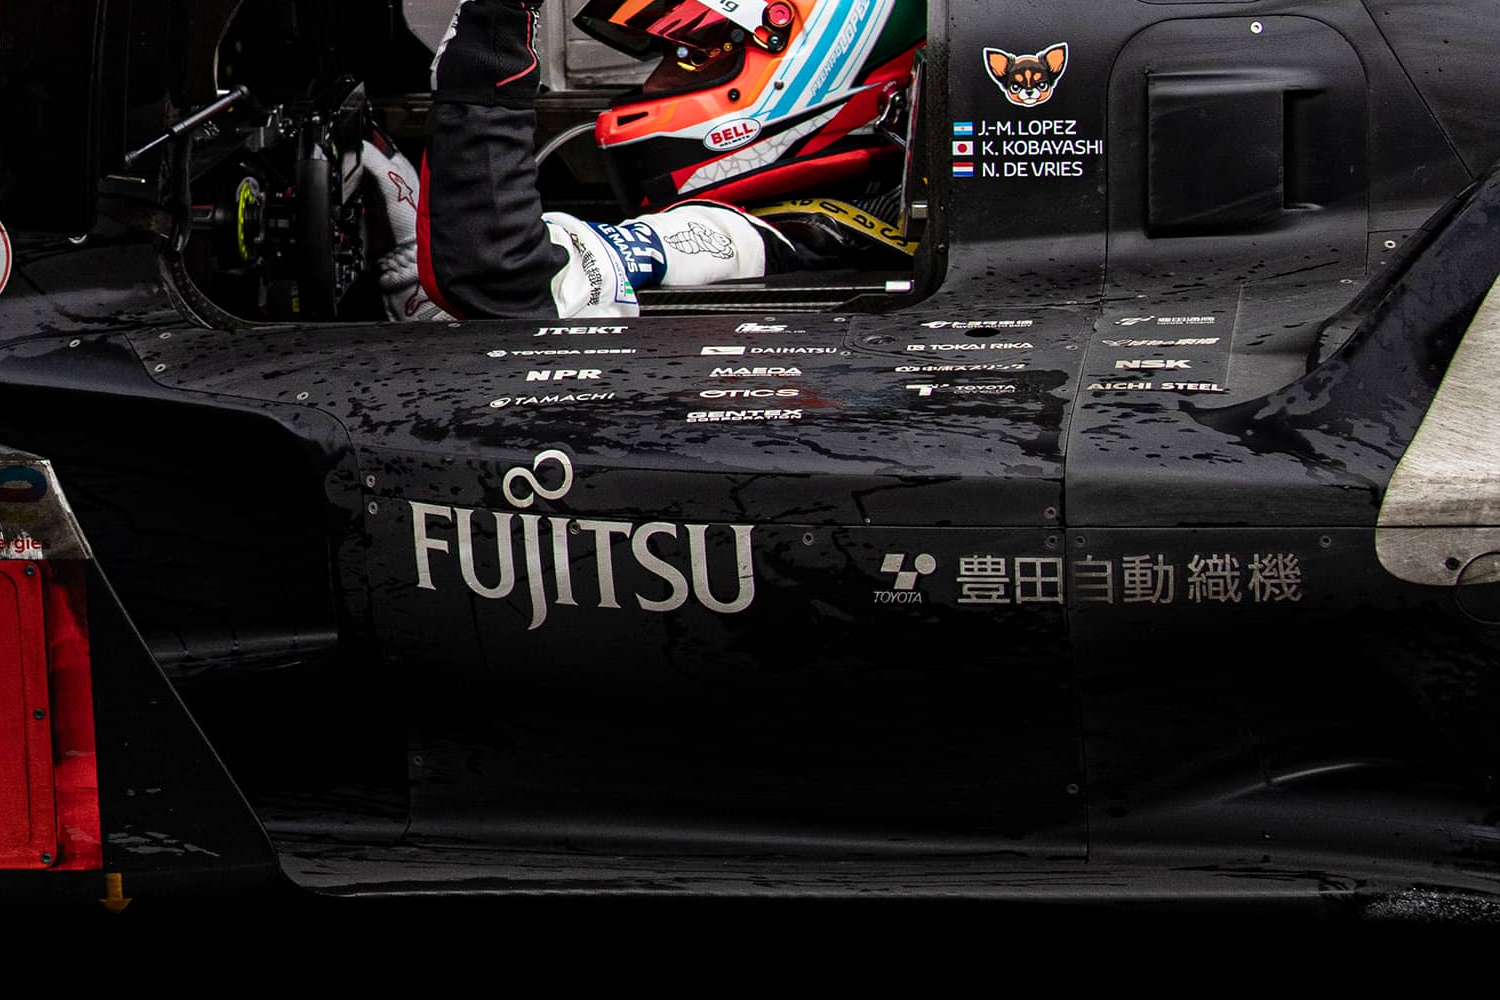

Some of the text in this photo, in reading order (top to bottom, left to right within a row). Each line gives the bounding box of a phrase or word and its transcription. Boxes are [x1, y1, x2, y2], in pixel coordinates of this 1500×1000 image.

[710, 122, 754, 145] BELL
[1018, 120, 1077, 136] LOPEZ
[981, 140, 1103, 156] K. KOBAYASHI
[982, 161, 1084, 177] N. DE VRIES
[598, 223, 639, 273] LE MANS
[533, 326, 628, 337] JTEKT
[930, 342, 1034, 351] TOKAI RIKA
[1114, 360, 1192, 369] NSK
[525, 369, 602, 381] NPR
[699, 388, 800, 398] OTICS
[1087, 382, 1224, 391] AICHI STEEL
[515, 392, 615, 405] TAMACHI
[408, 499, 757, 630] FUJITSU
[957, 553, 1303, 604] 豊田自動織機
[873, 590, 923, 604] TOYOTA
